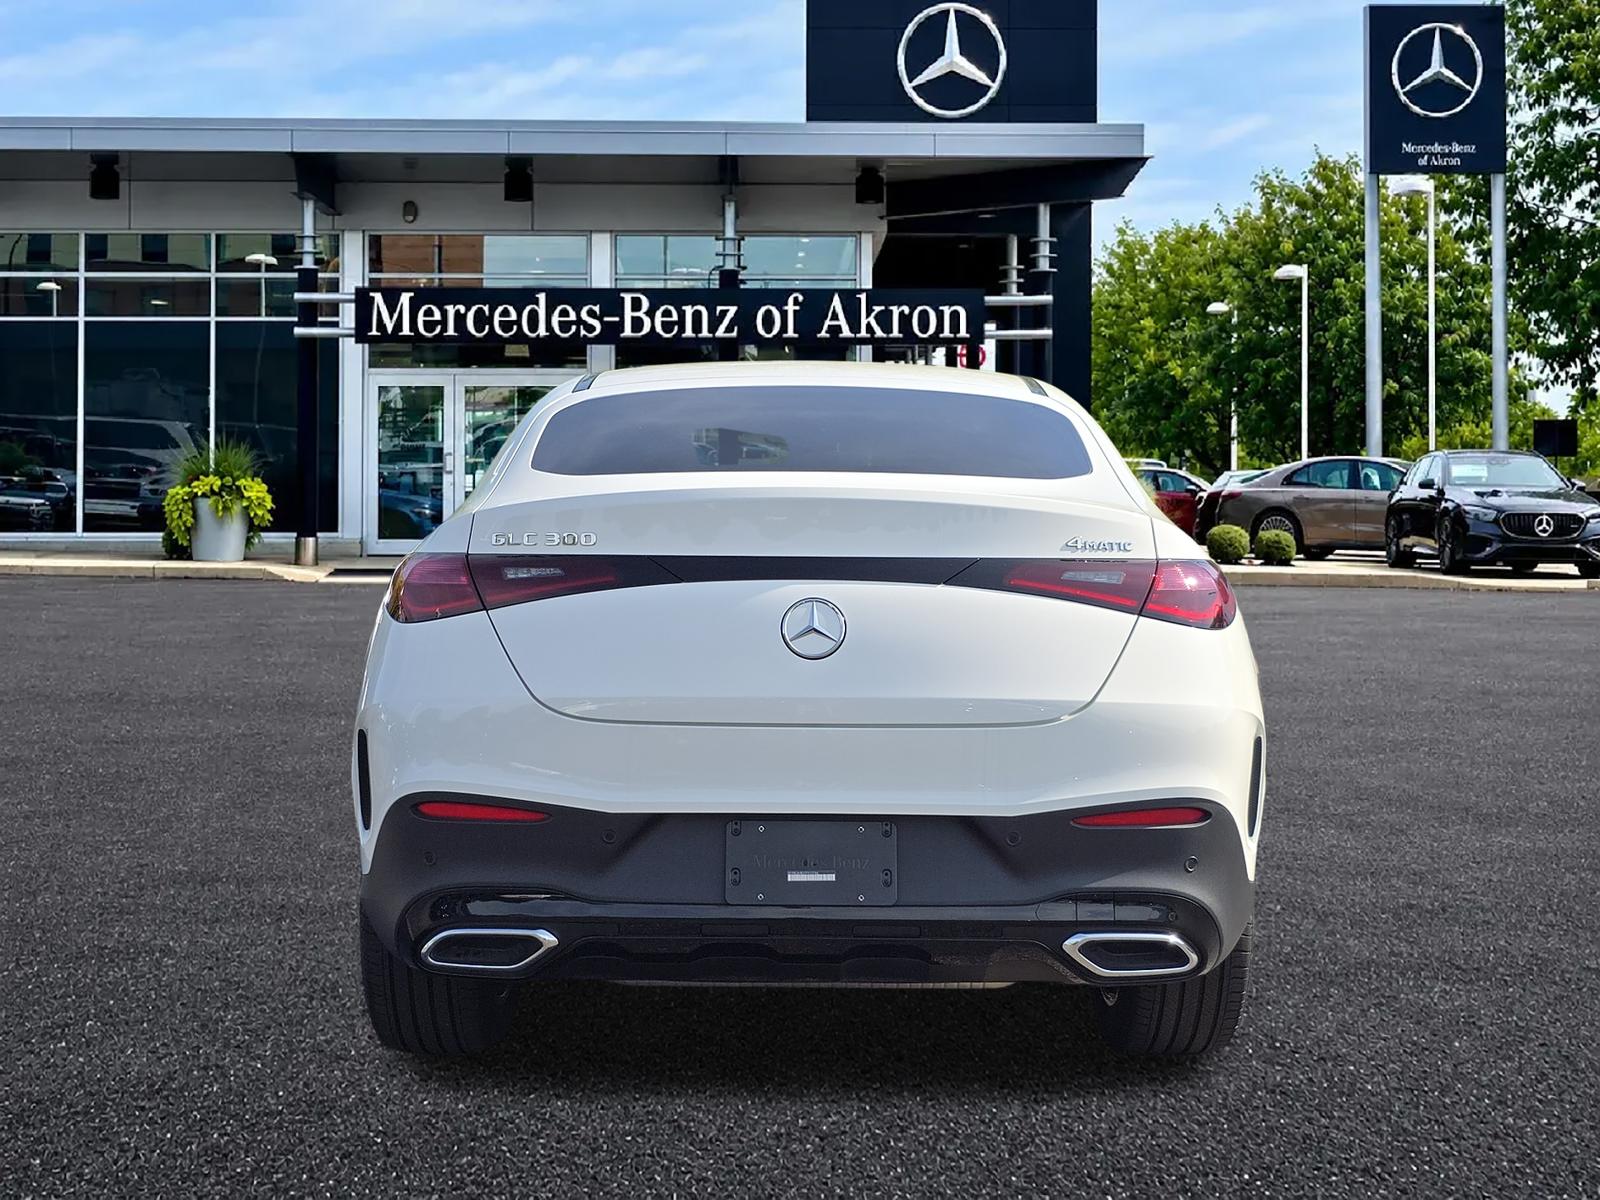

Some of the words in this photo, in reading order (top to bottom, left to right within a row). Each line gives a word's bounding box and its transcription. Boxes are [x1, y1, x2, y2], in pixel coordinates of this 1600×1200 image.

[1401, 141, 1477, 153] Mercedes-Benz
[1417, 154, 1428, 166] of
[1430, 154, 1461, 166] Akron
[367, 291, 738, 339] Mercedes-Benz
[755, 291, 804, 339] of
[816, 291, 971, 339] Akron
[491, 531, 538, 546] GLC
[544, 531, 598, 546] 300
[1064, 535, 1133, 552] 4MATIC
